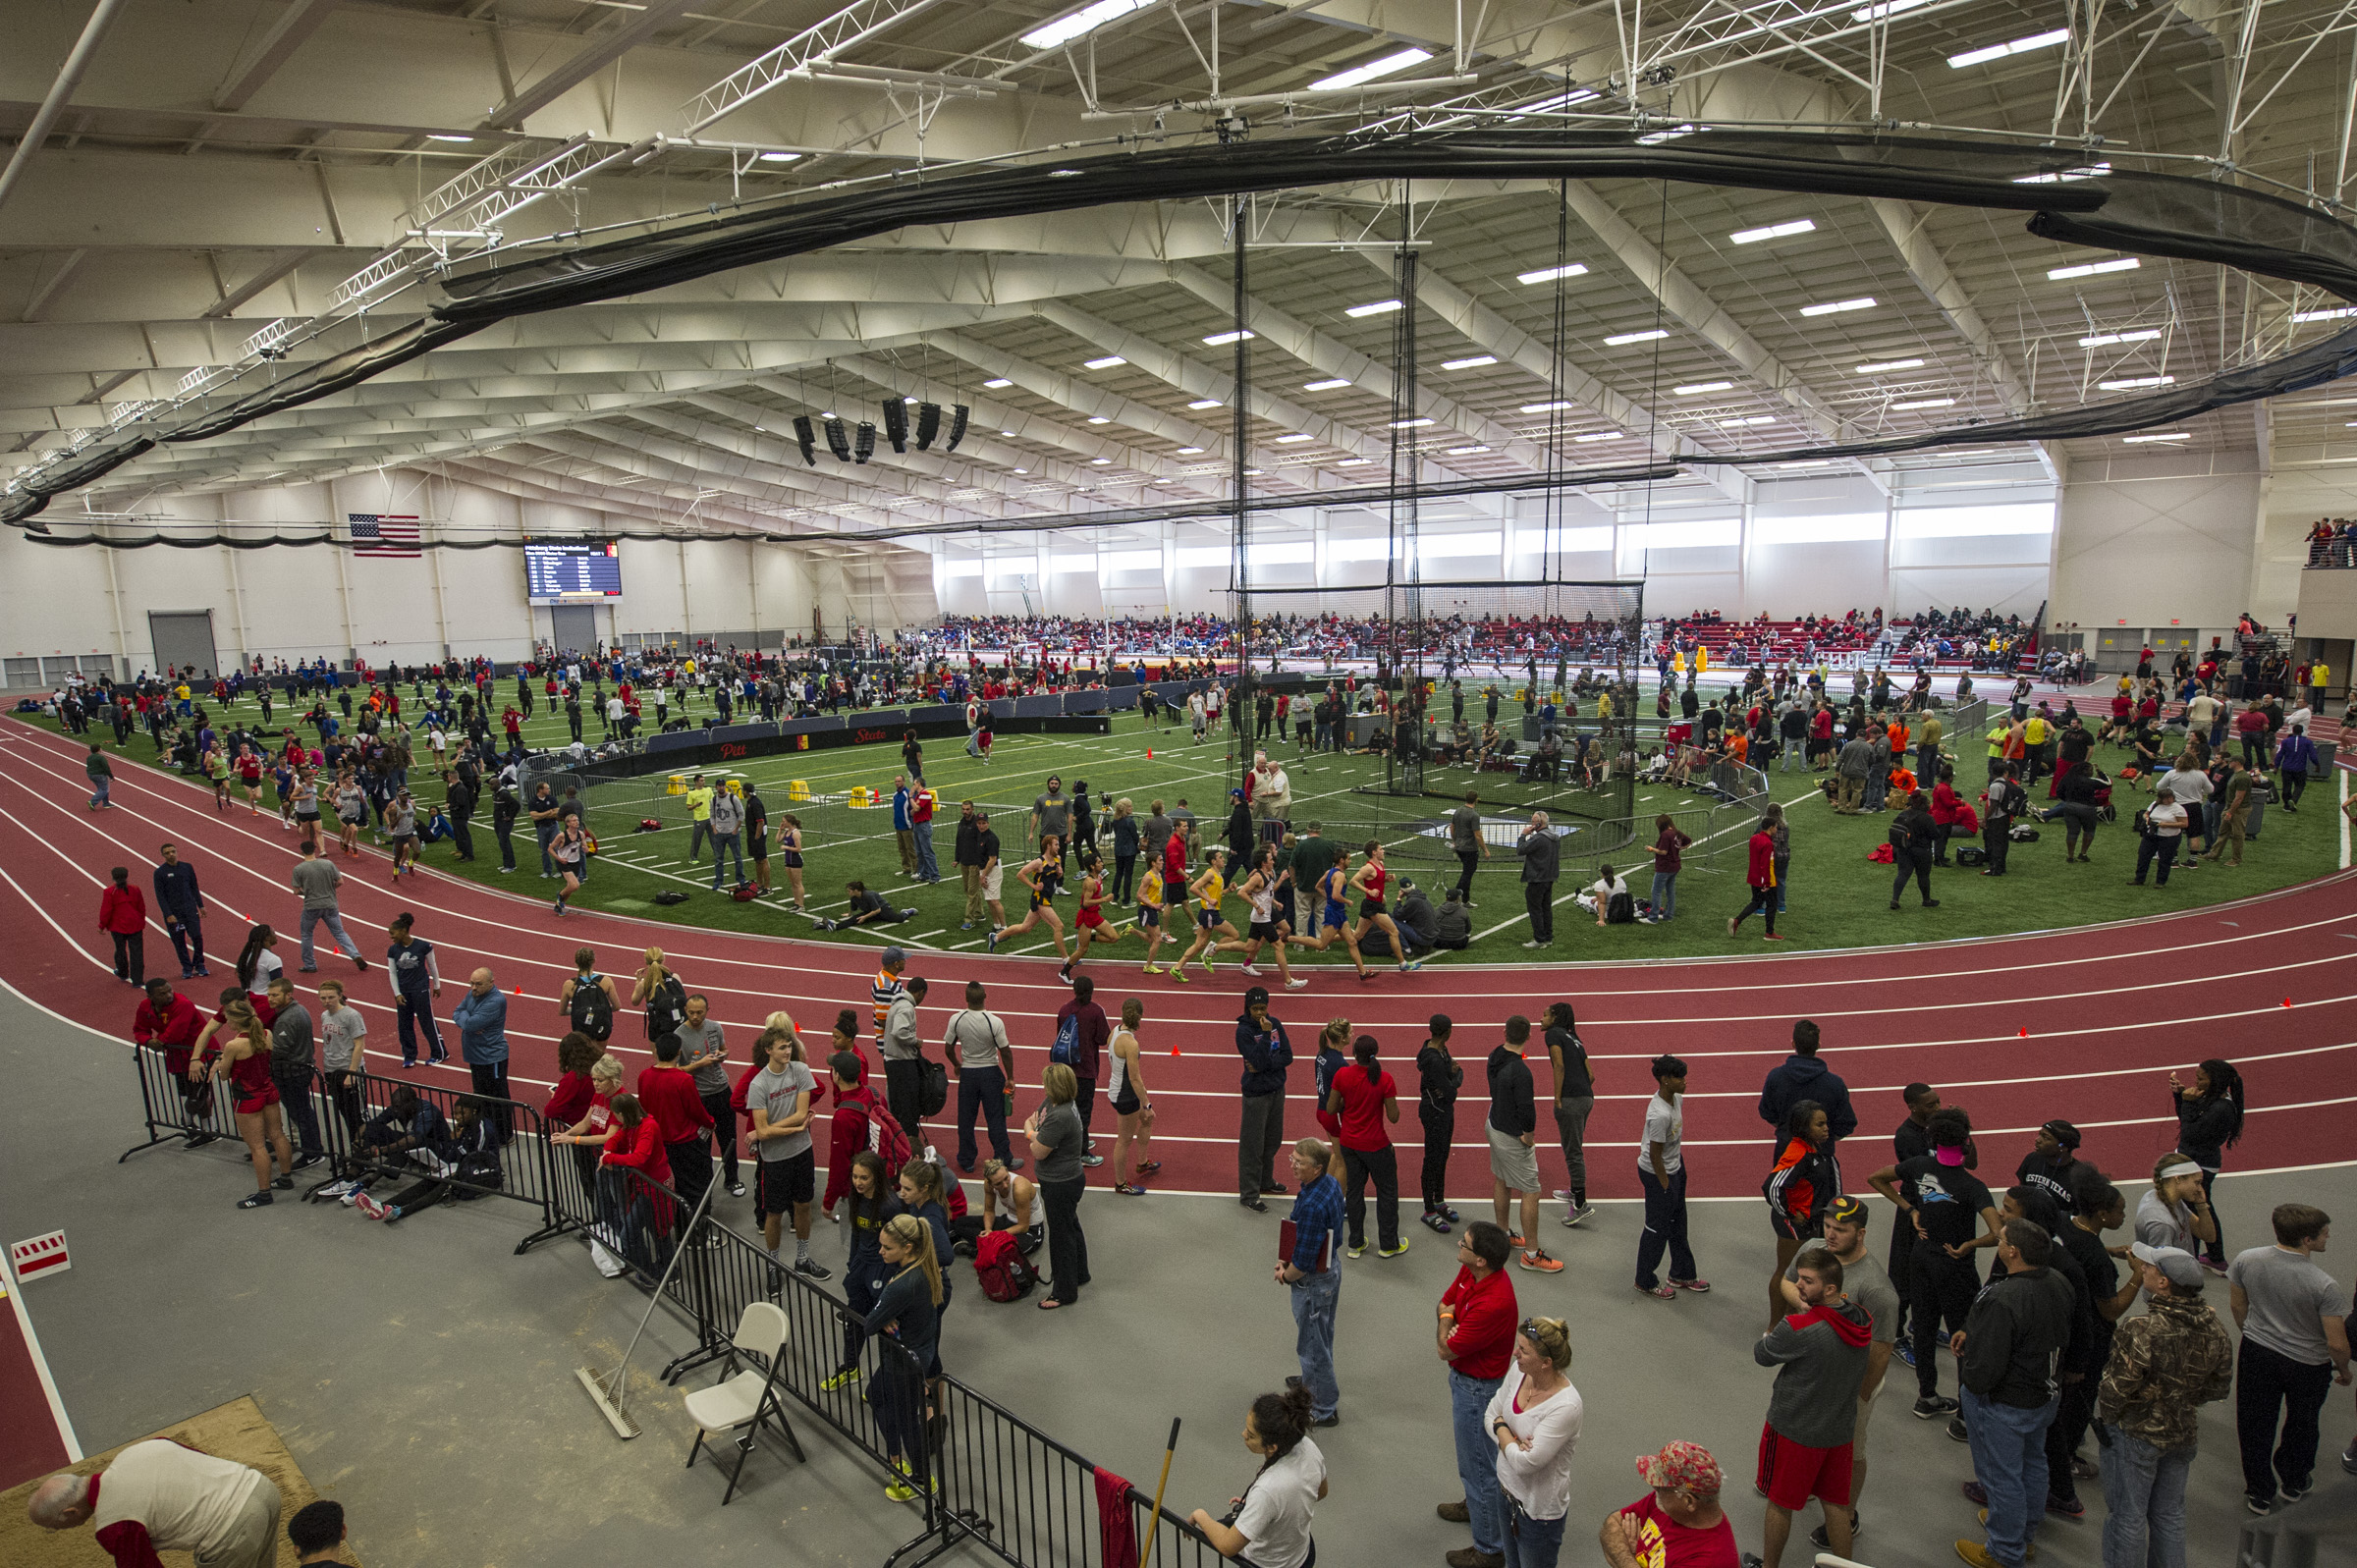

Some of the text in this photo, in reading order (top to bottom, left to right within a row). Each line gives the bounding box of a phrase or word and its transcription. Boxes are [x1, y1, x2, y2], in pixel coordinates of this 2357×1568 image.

[854, 729, 887, 743] State
[720, 743, 747, 760] Pitt
[2050, 1181, 2072, 1203] TEXAS
